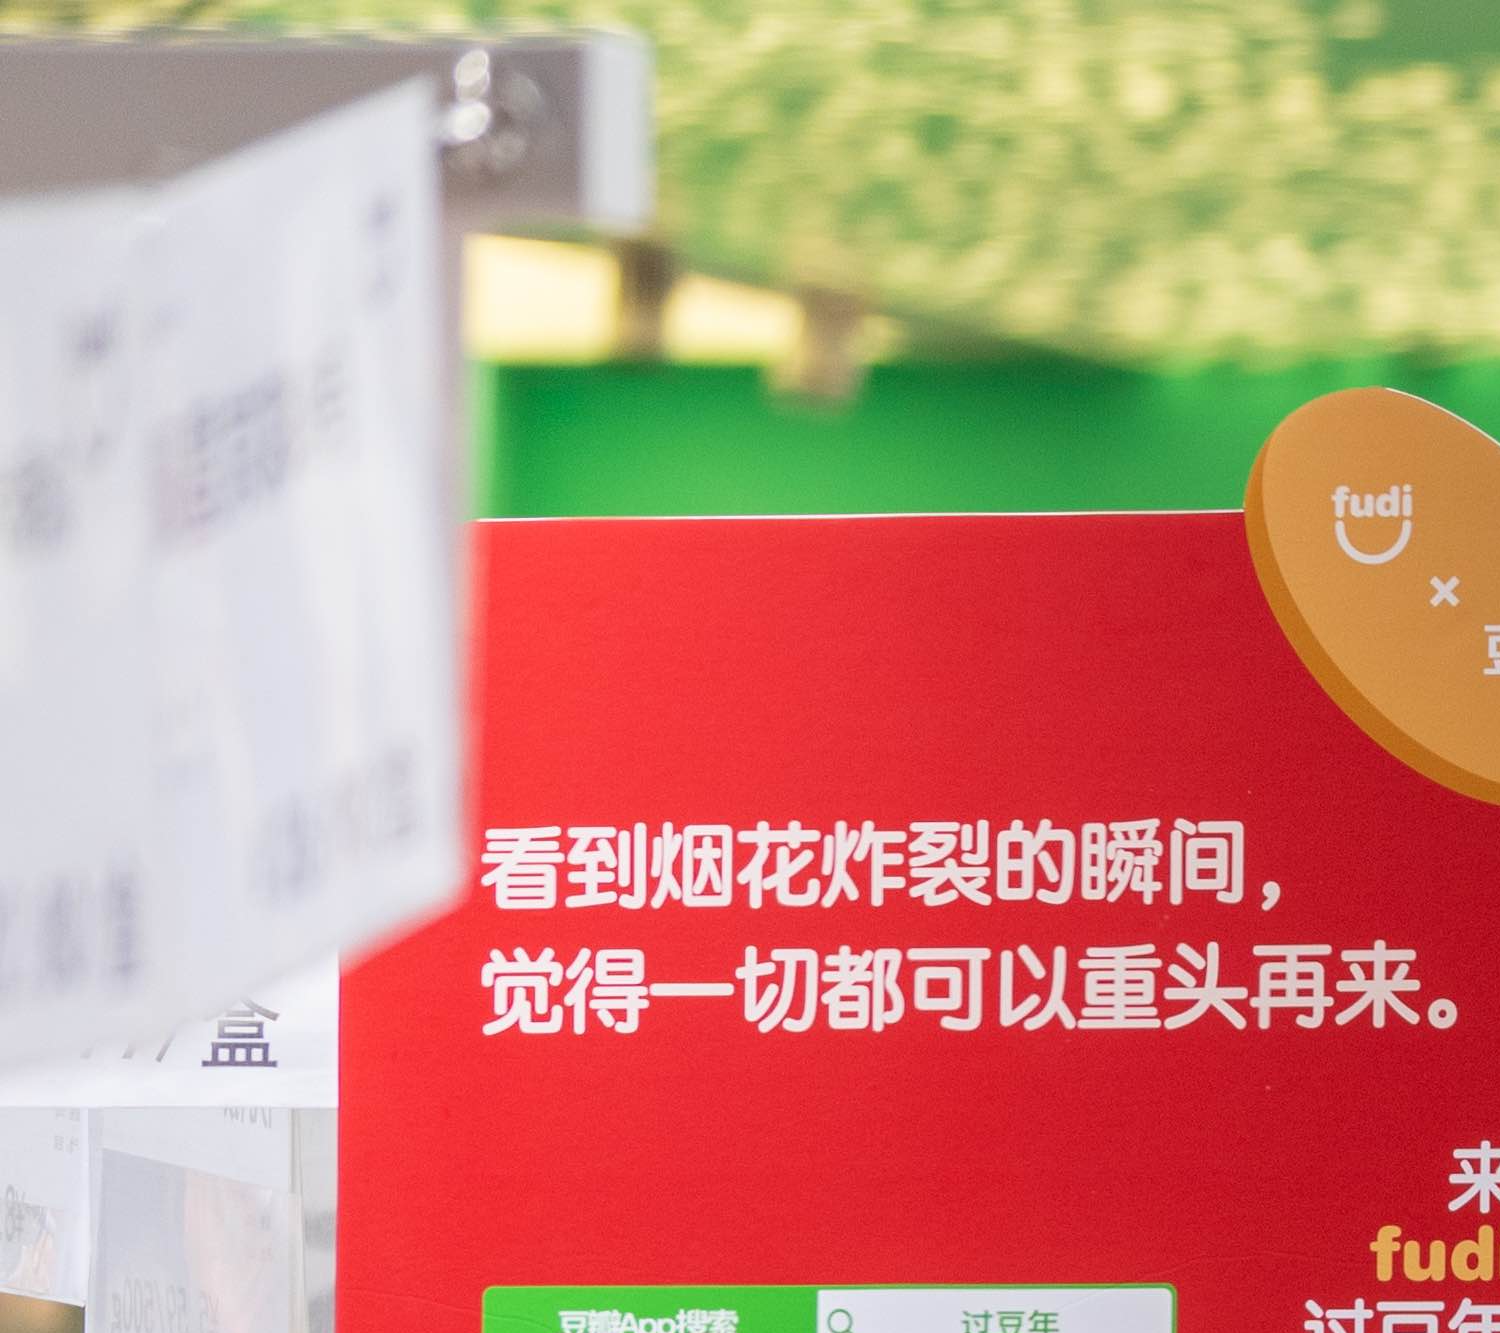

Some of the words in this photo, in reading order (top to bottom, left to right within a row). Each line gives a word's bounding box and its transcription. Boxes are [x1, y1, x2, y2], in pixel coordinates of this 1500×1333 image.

[1331, 484, 1413, 519] fudi
[481, 820, 1281, 911] 看到烟花炸裂的瞬间，
[481, 938, 1458, 1036] 觉得一切都可以重头再来。
